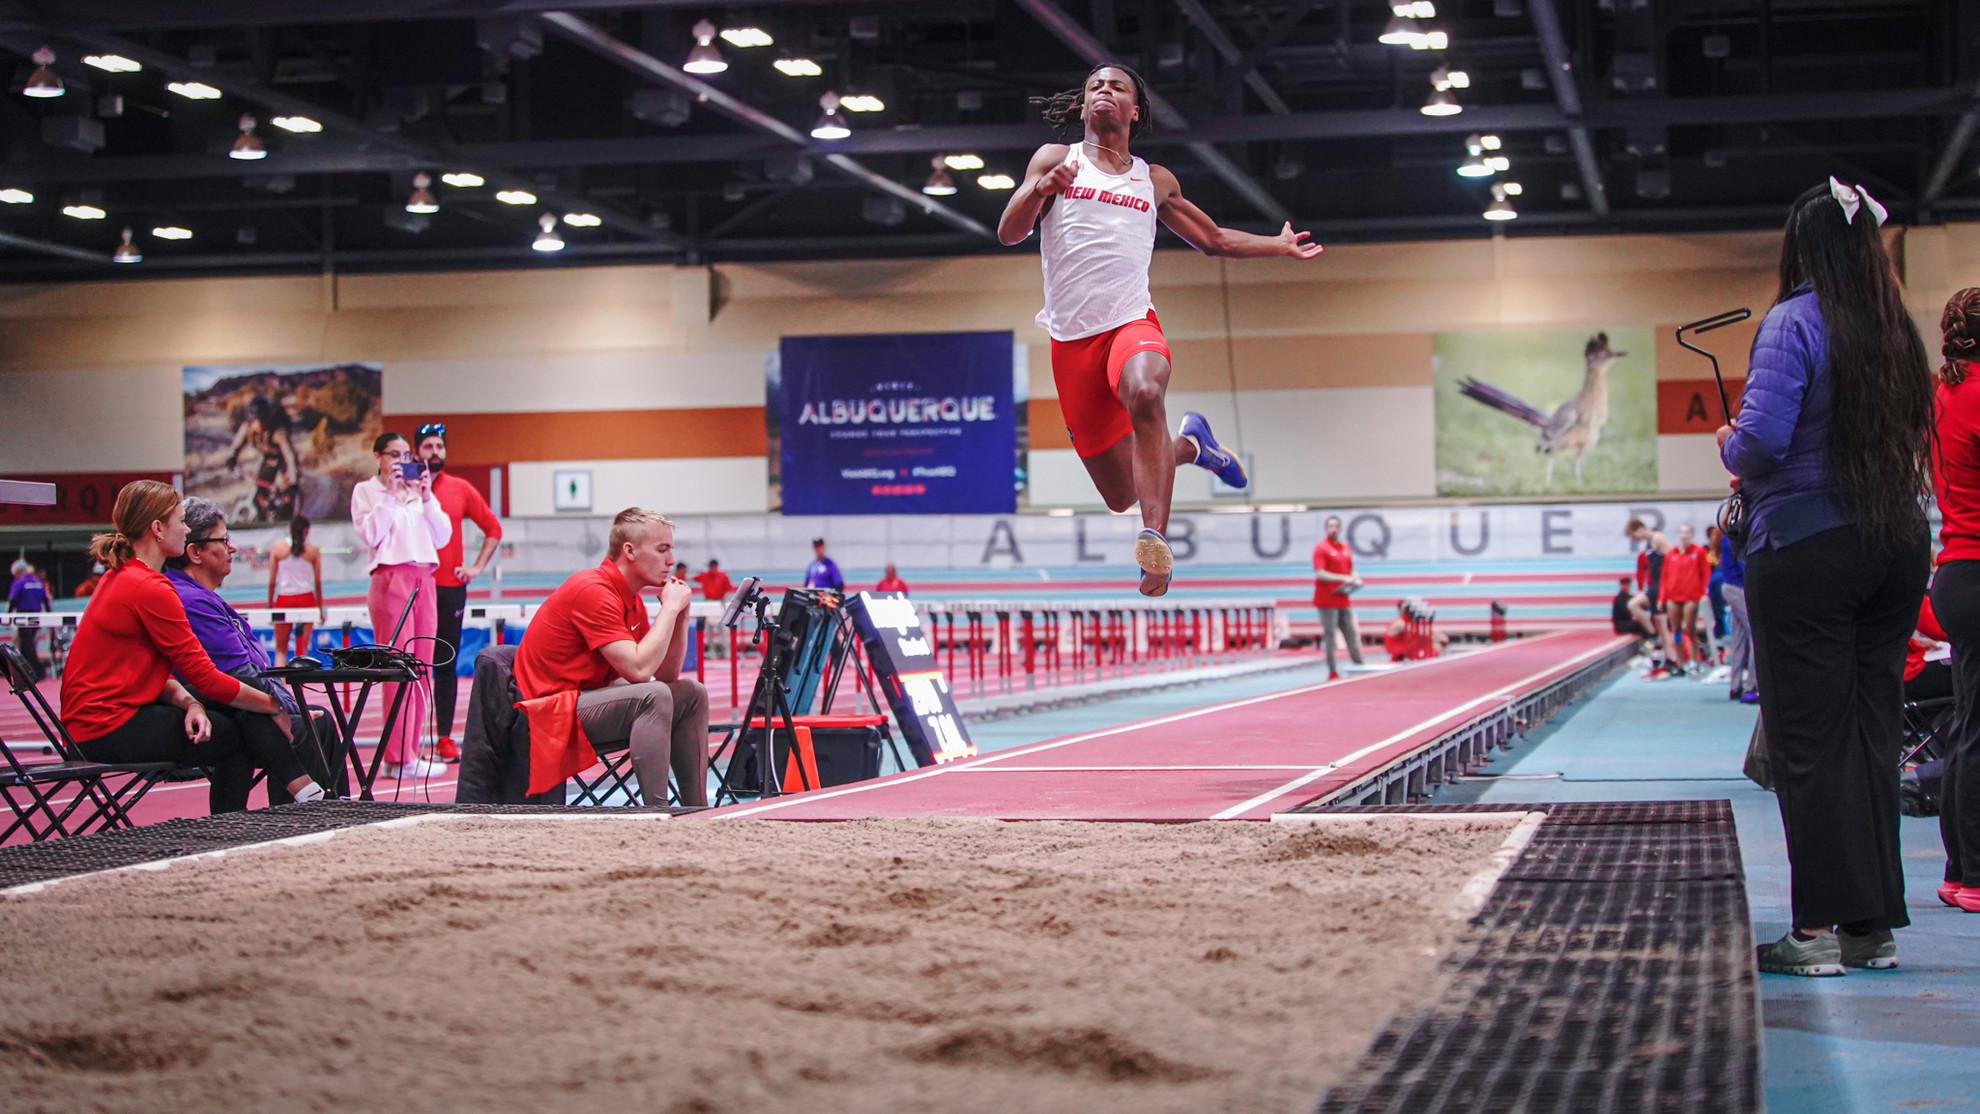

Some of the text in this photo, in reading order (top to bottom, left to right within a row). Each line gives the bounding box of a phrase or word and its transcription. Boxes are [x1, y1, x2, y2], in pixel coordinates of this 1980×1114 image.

[1064, 186, 1150, 213] NEW MEXICO
[798, 397, 996, 425] ALBUQUERQUE
[0, 617, 40, 627] UCS
